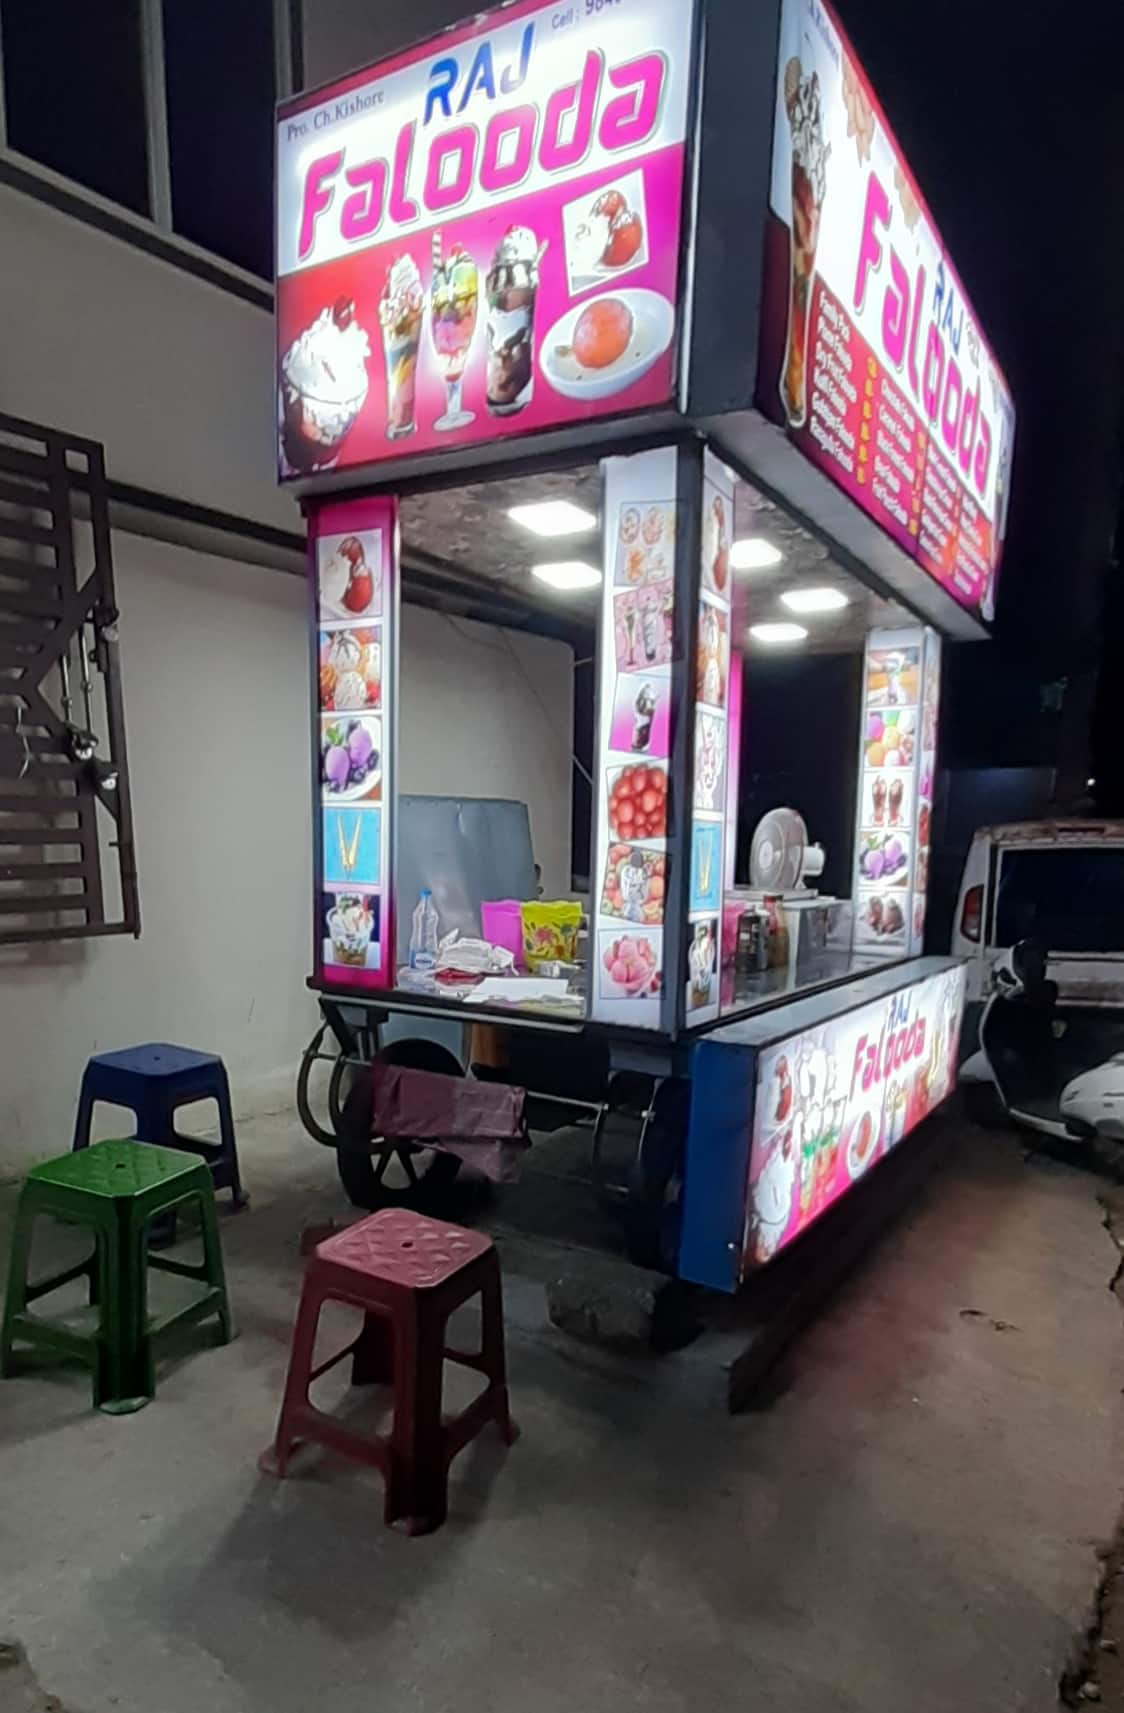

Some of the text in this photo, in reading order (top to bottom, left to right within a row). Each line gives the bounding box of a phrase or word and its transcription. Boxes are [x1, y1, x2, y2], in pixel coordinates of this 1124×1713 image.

[423, 21, 535, 126] RAJ
[297, 47, 668, 261] Falooda
[853, 170, 991, 498] Falooda
[933, 261, 964, 356] RAJ
[851, 1010, 926, 1098] Falooda
[887, 990, 913, 1033] RAJ
